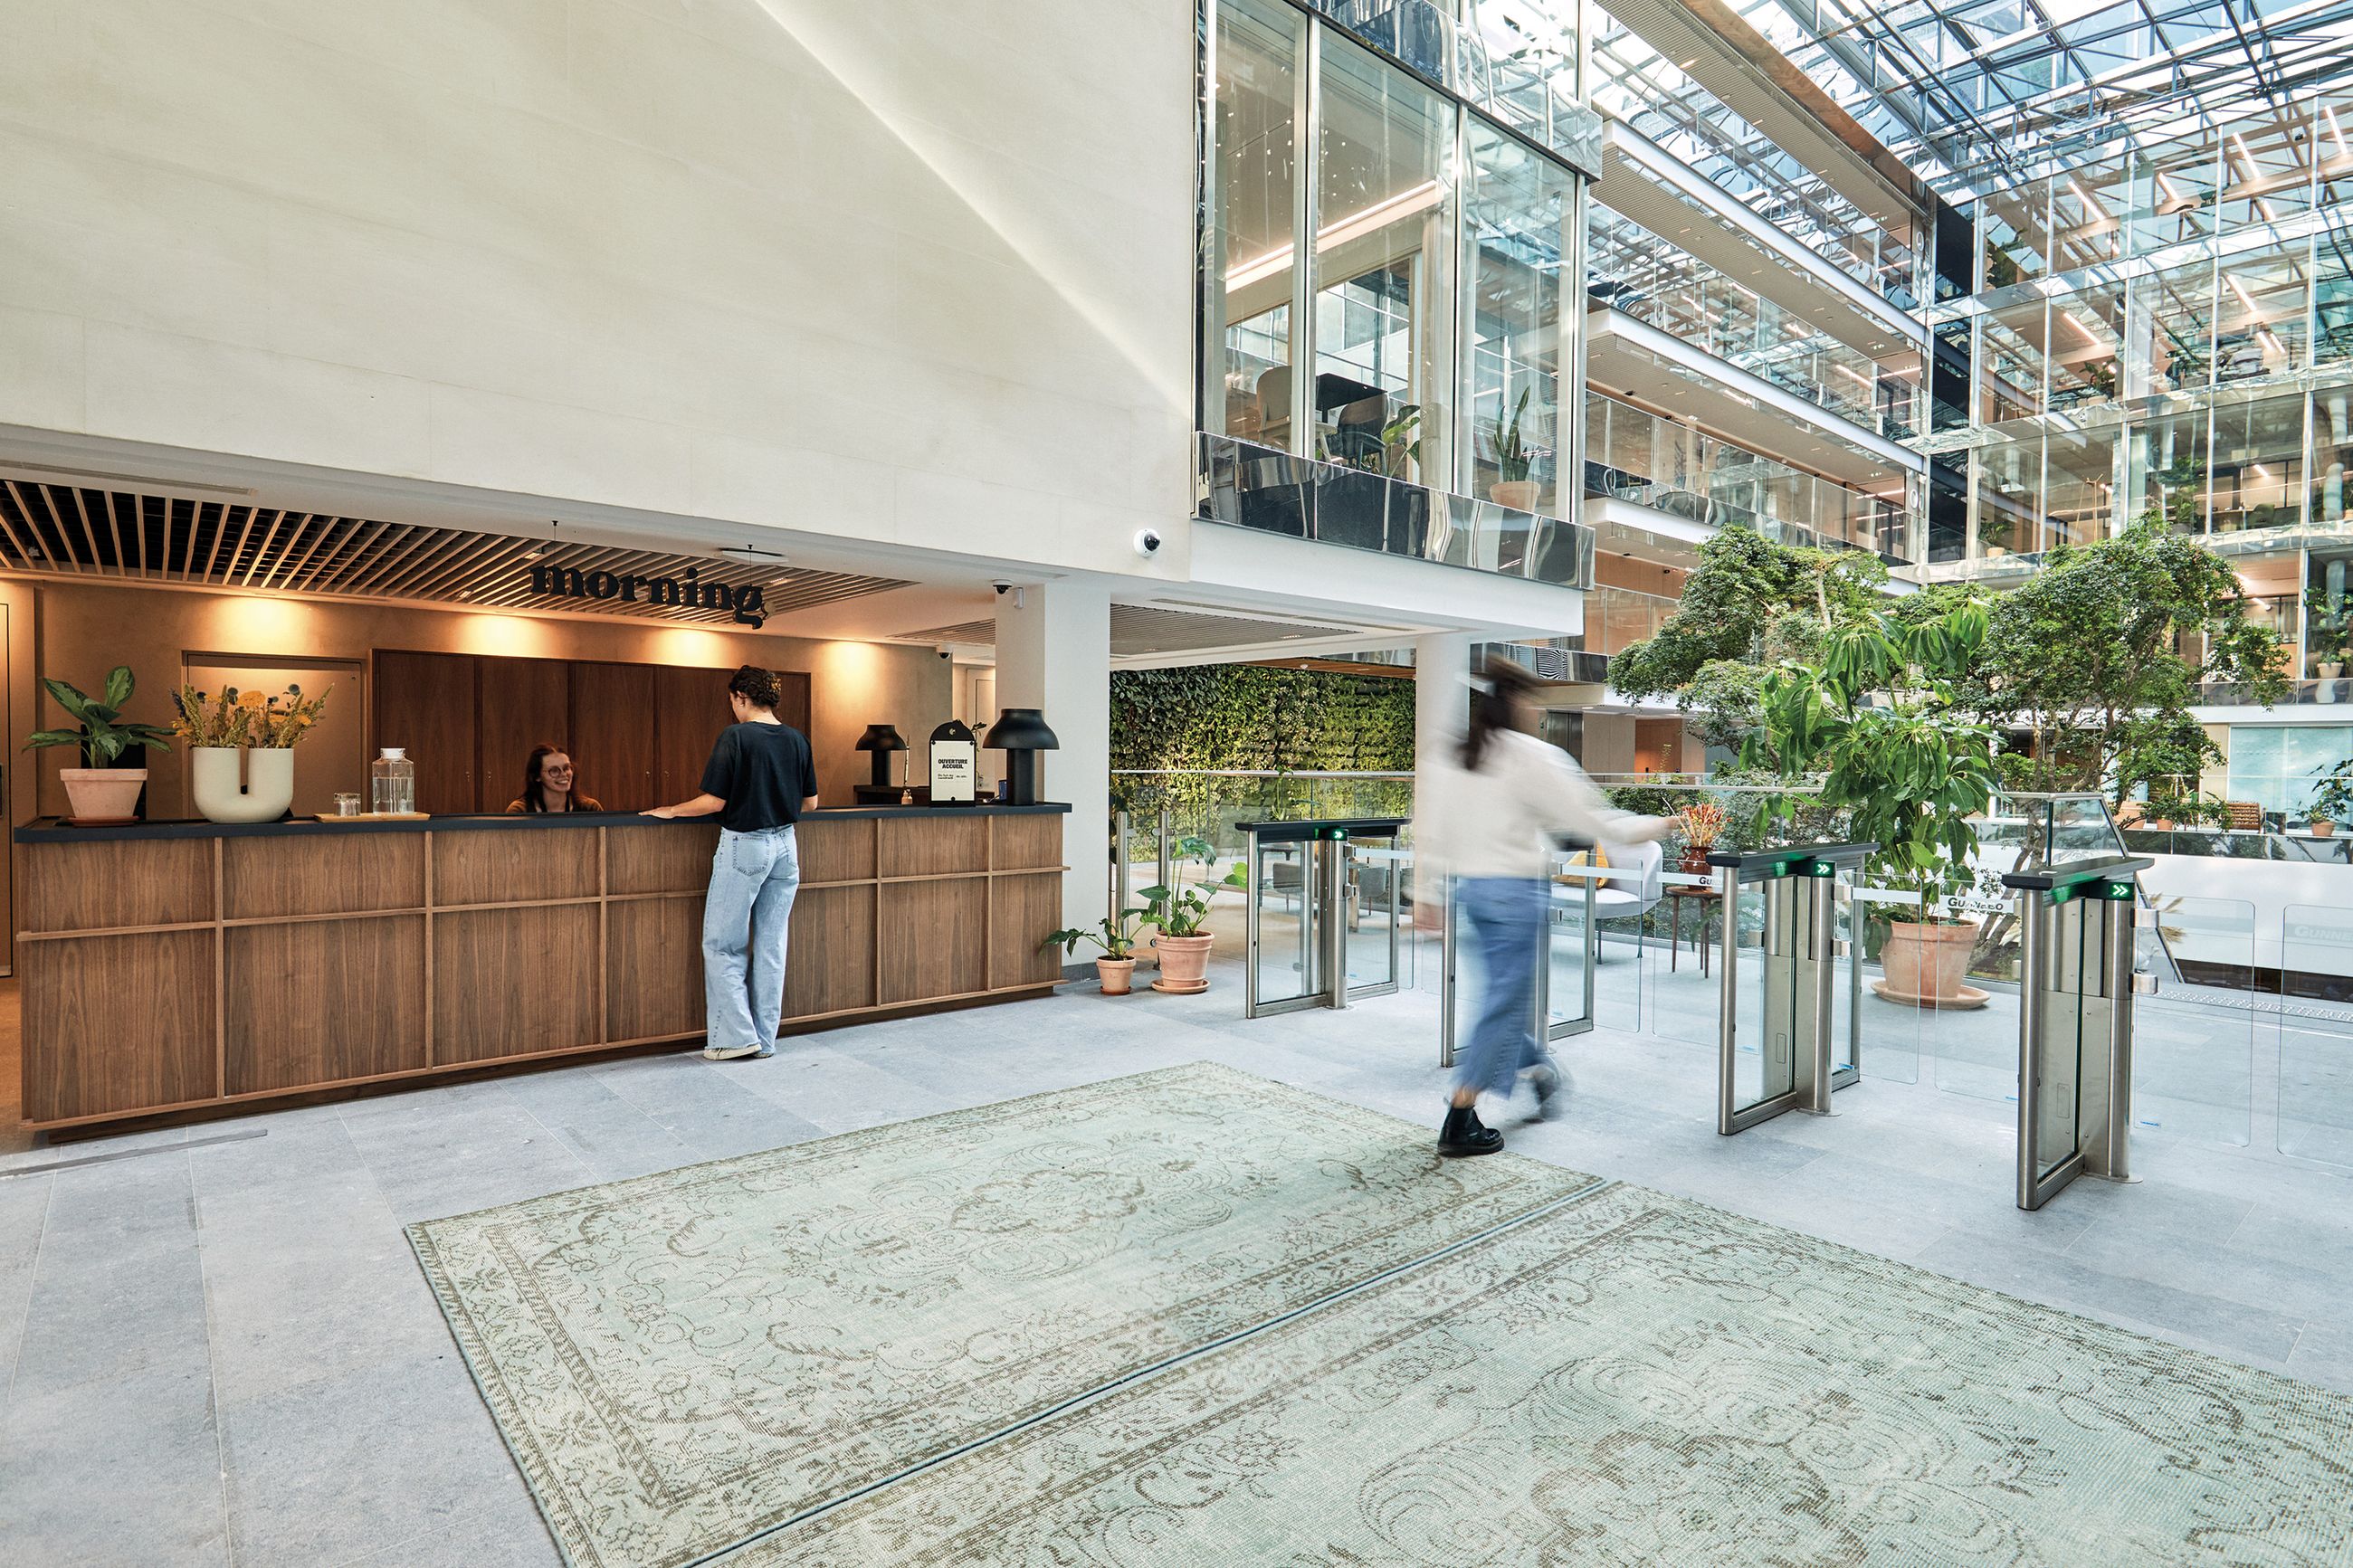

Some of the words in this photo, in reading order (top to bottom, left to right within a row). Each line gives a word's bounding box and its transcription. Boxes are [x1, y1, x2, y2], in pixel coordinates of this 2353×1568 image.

[529, 565, 767, 630] morning
[1948, 897, 2004, 911] GUNEBO
[2294, 925, 2353, 942] GUNNE
